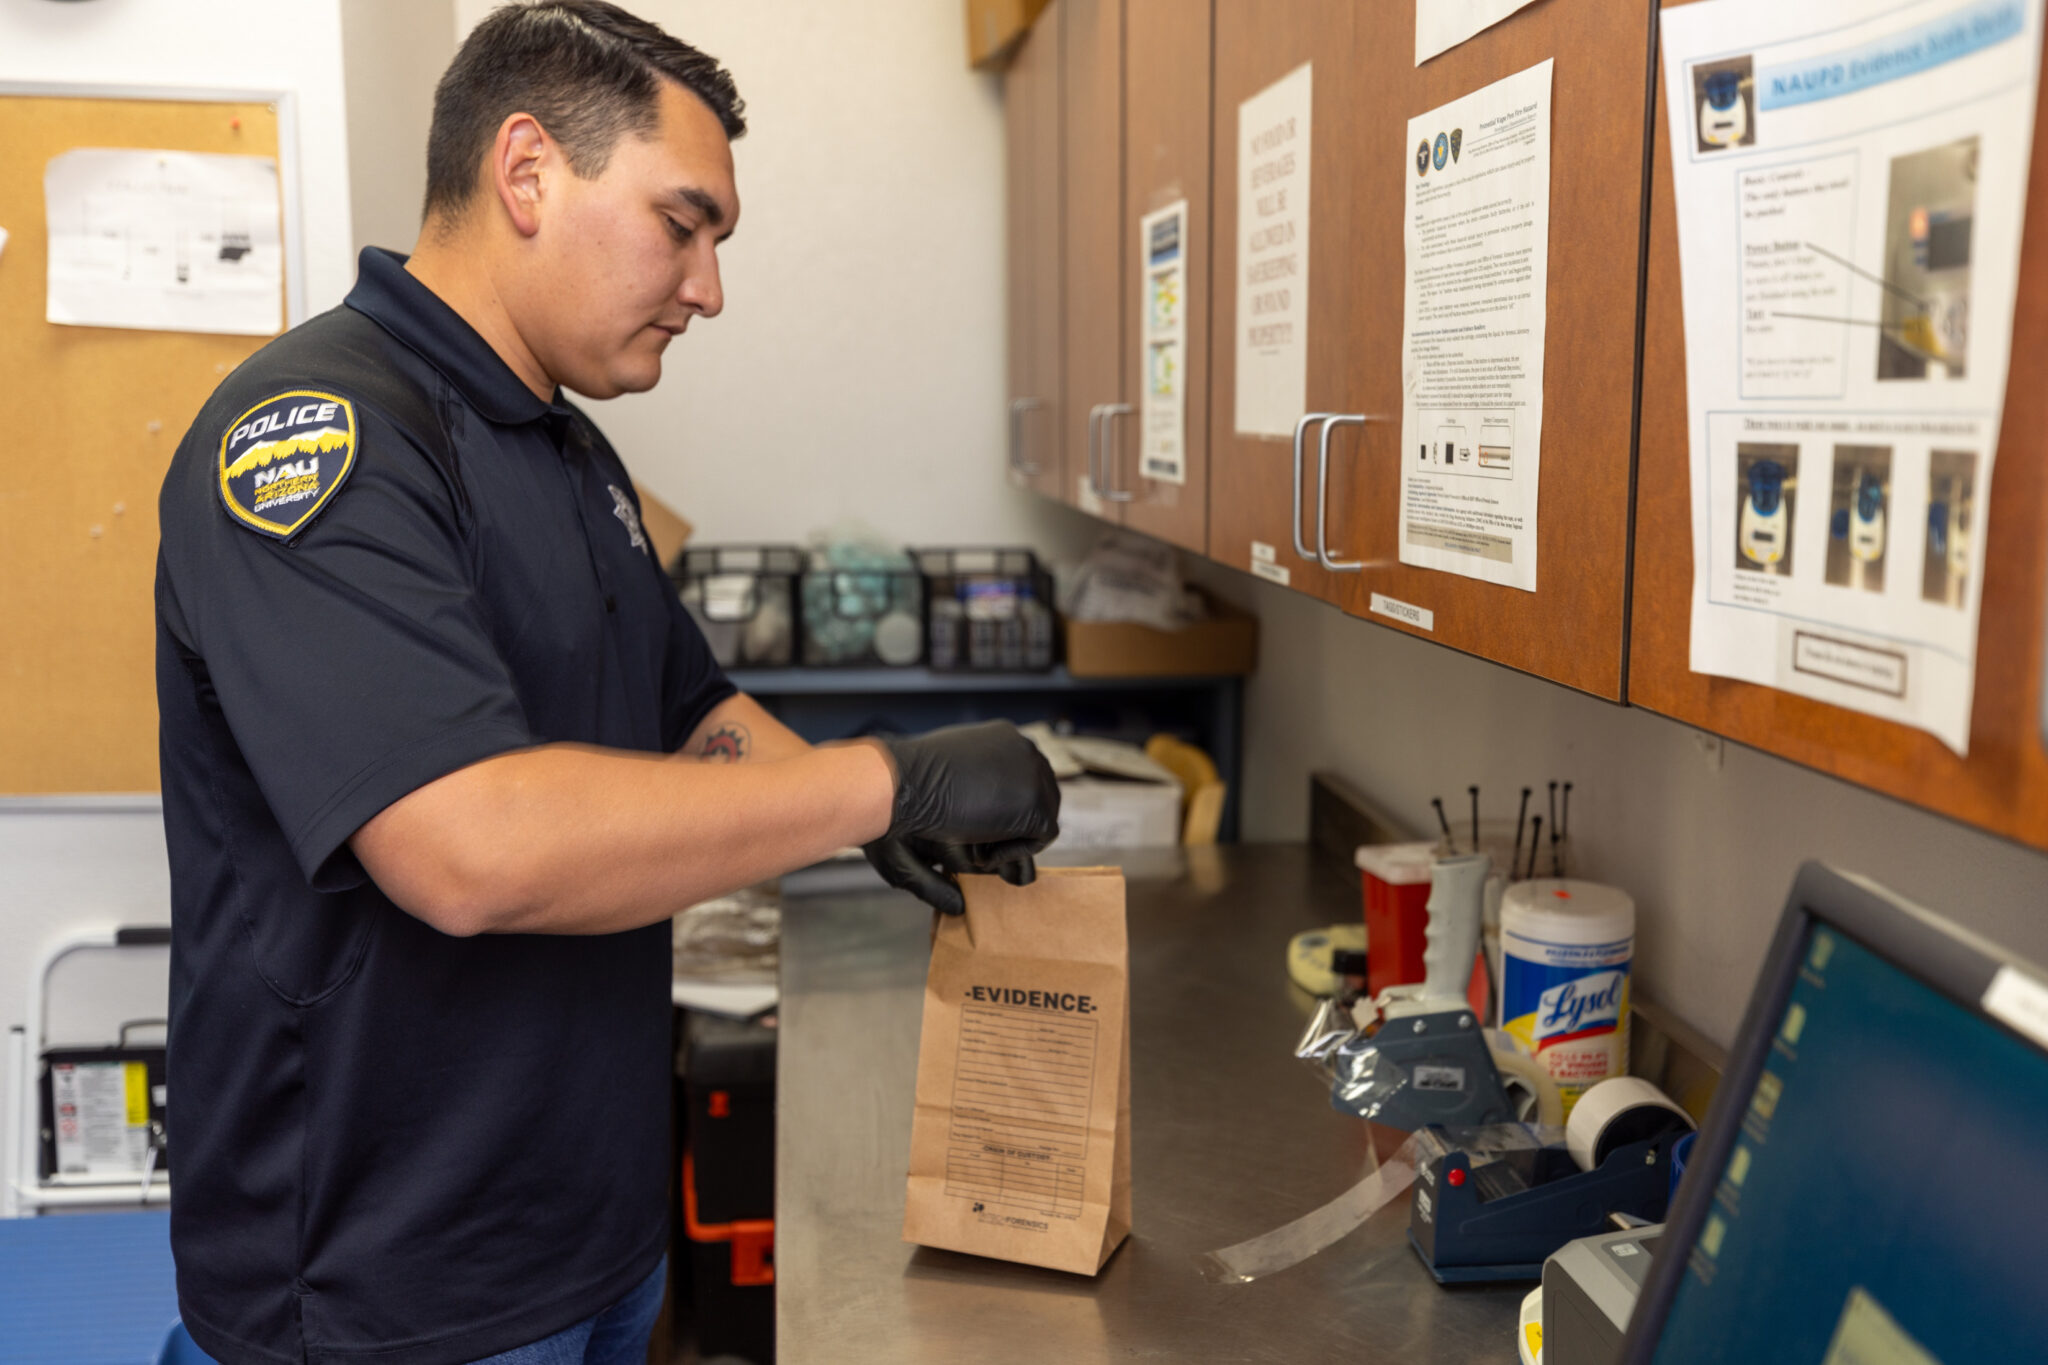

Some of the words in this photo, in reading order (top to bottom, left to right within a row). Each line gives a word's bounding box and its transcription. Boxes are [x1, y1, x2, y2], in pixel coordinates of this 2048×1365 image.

[1771, 65, 1845, 96] NAUPD
[229, 402, 339, 450] POLICE
[254, 456, 319, 488] NAU
[254, 471, 319, 496] NORTHERN
[254, 481, 321, 504] ARIZONA
[254, 486, 321, 513] UNIVERSITY
[1542, 974, 1622, 1032] Lysol
